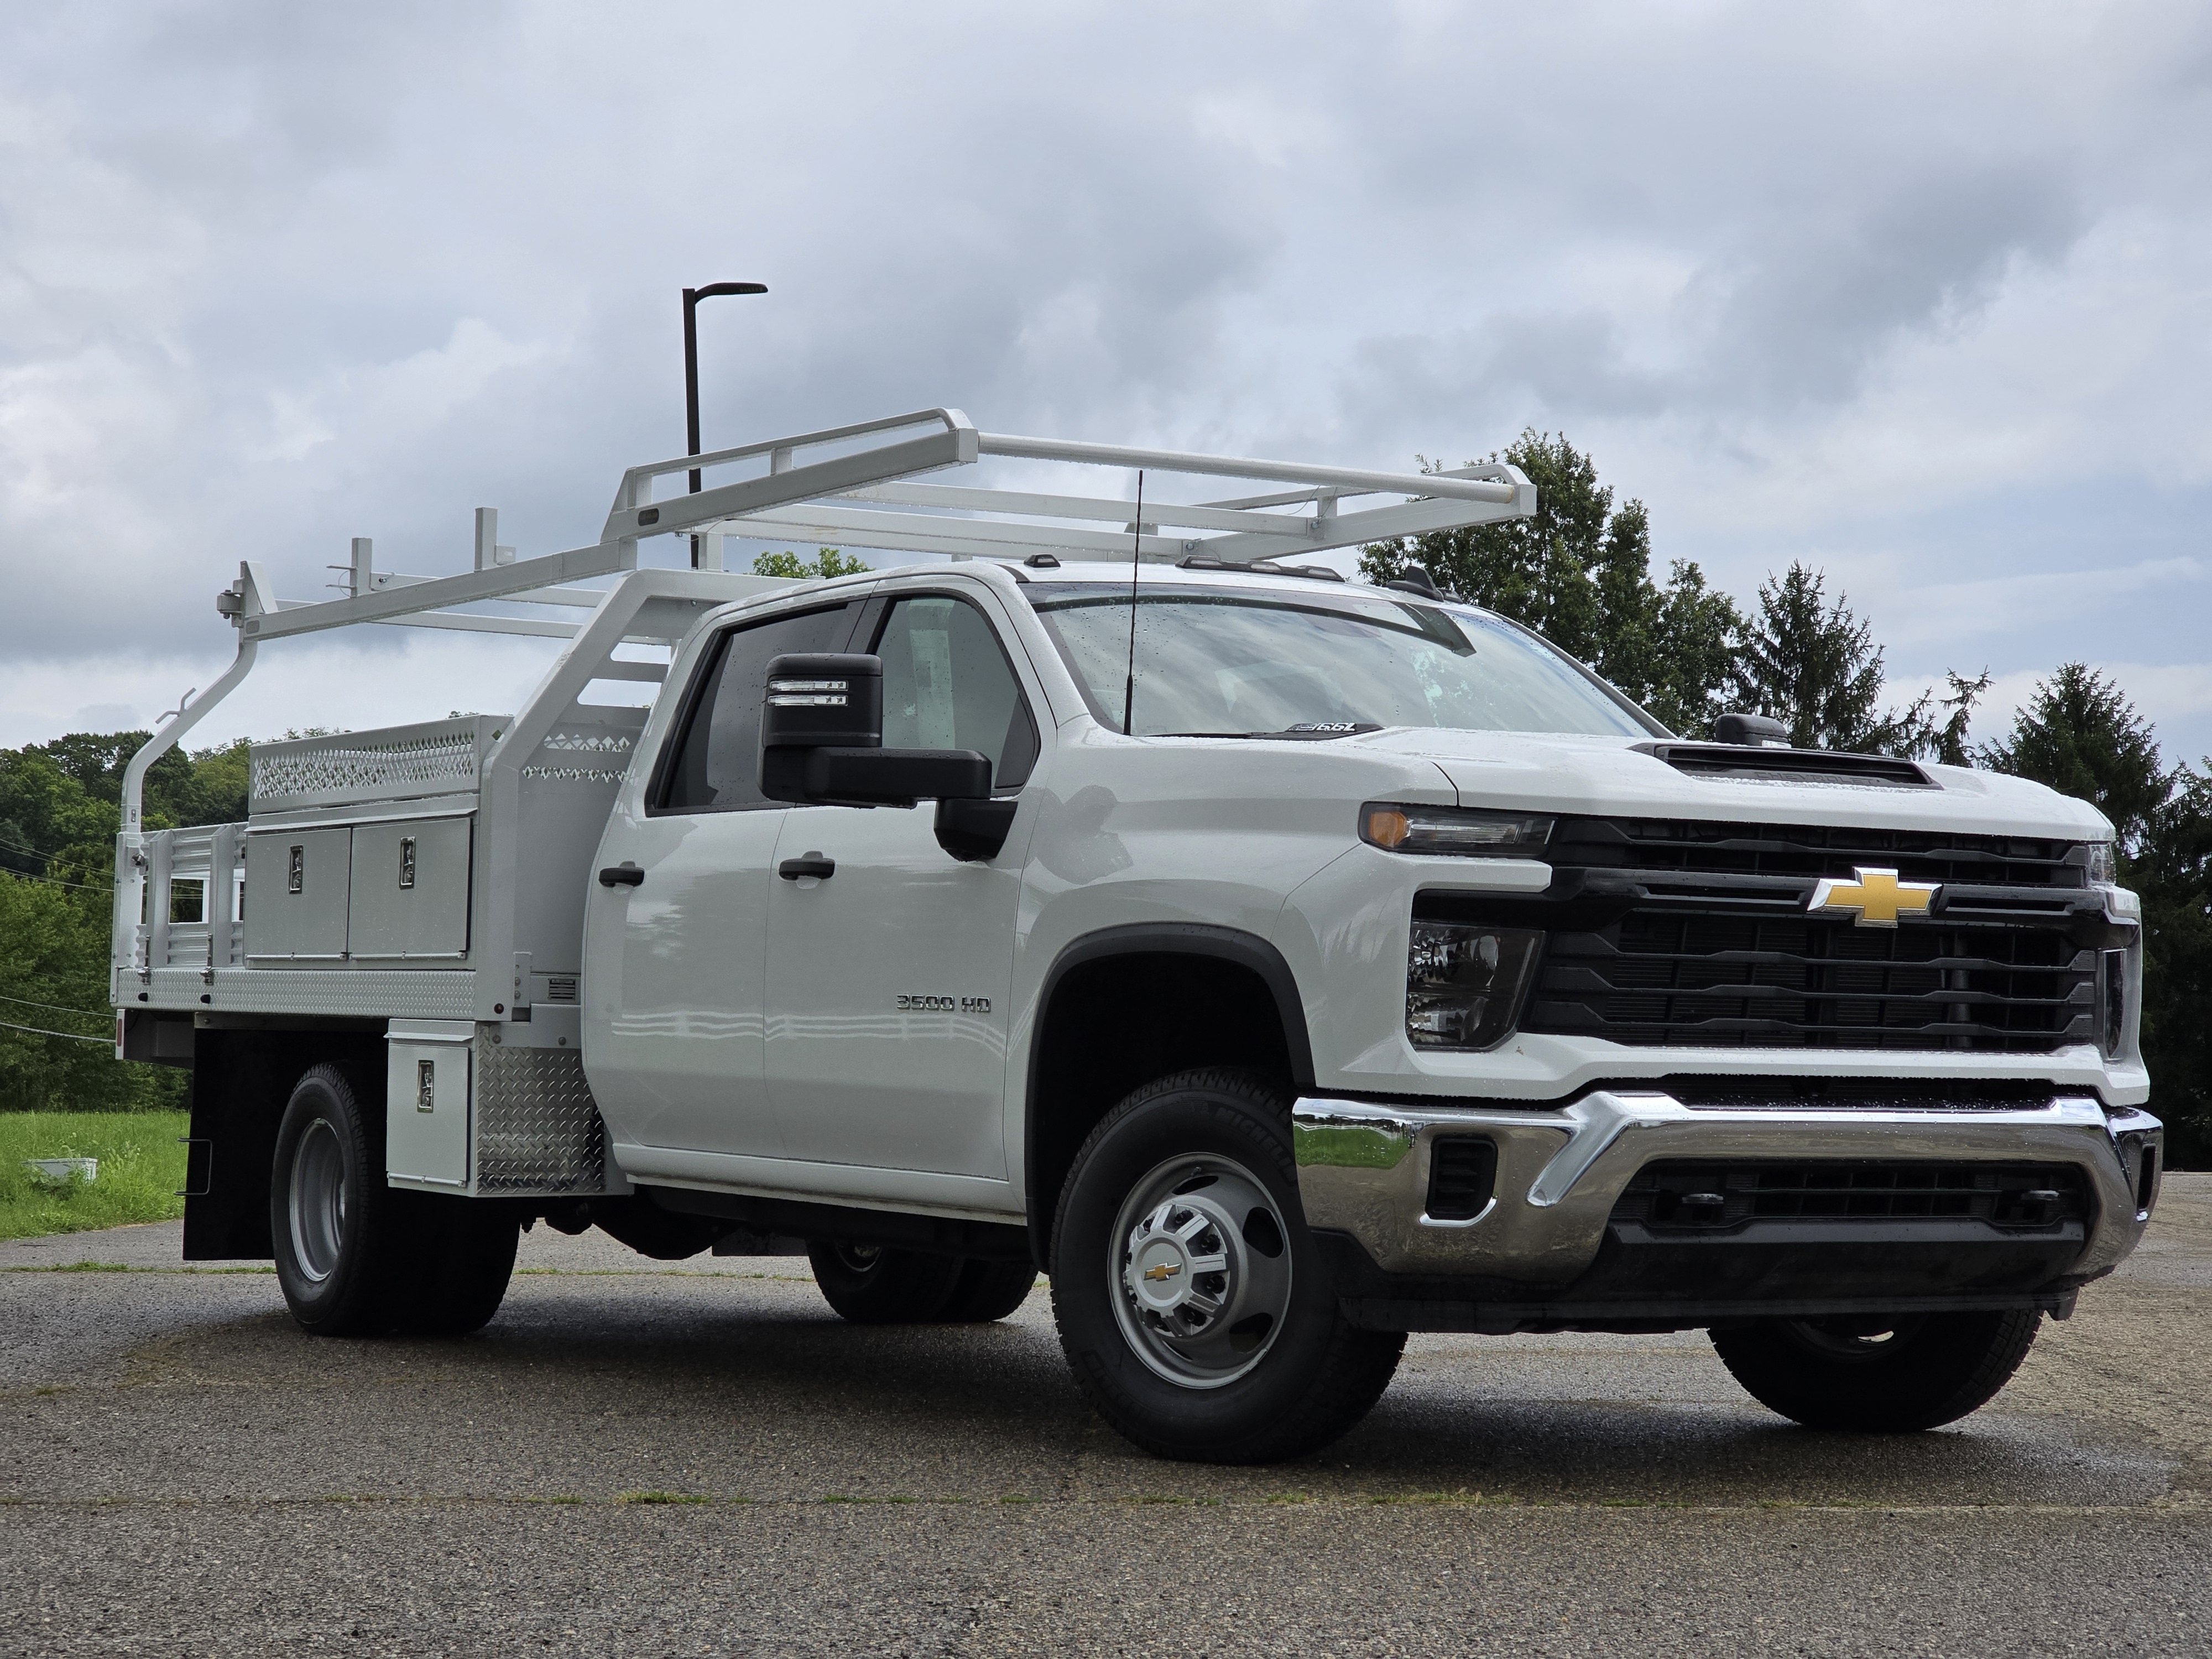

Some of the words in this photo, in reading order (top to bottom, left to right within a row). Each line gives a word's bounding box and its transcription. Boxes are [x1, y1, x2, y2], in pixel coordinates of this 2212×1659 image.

[1754, 771, 1874, 785] CHEVROLET
[896, 994, 954, 1011] 3500
[962, 996, 991, 1013] HD
[1214, 1107, 1297, 1183] MICHELIN
